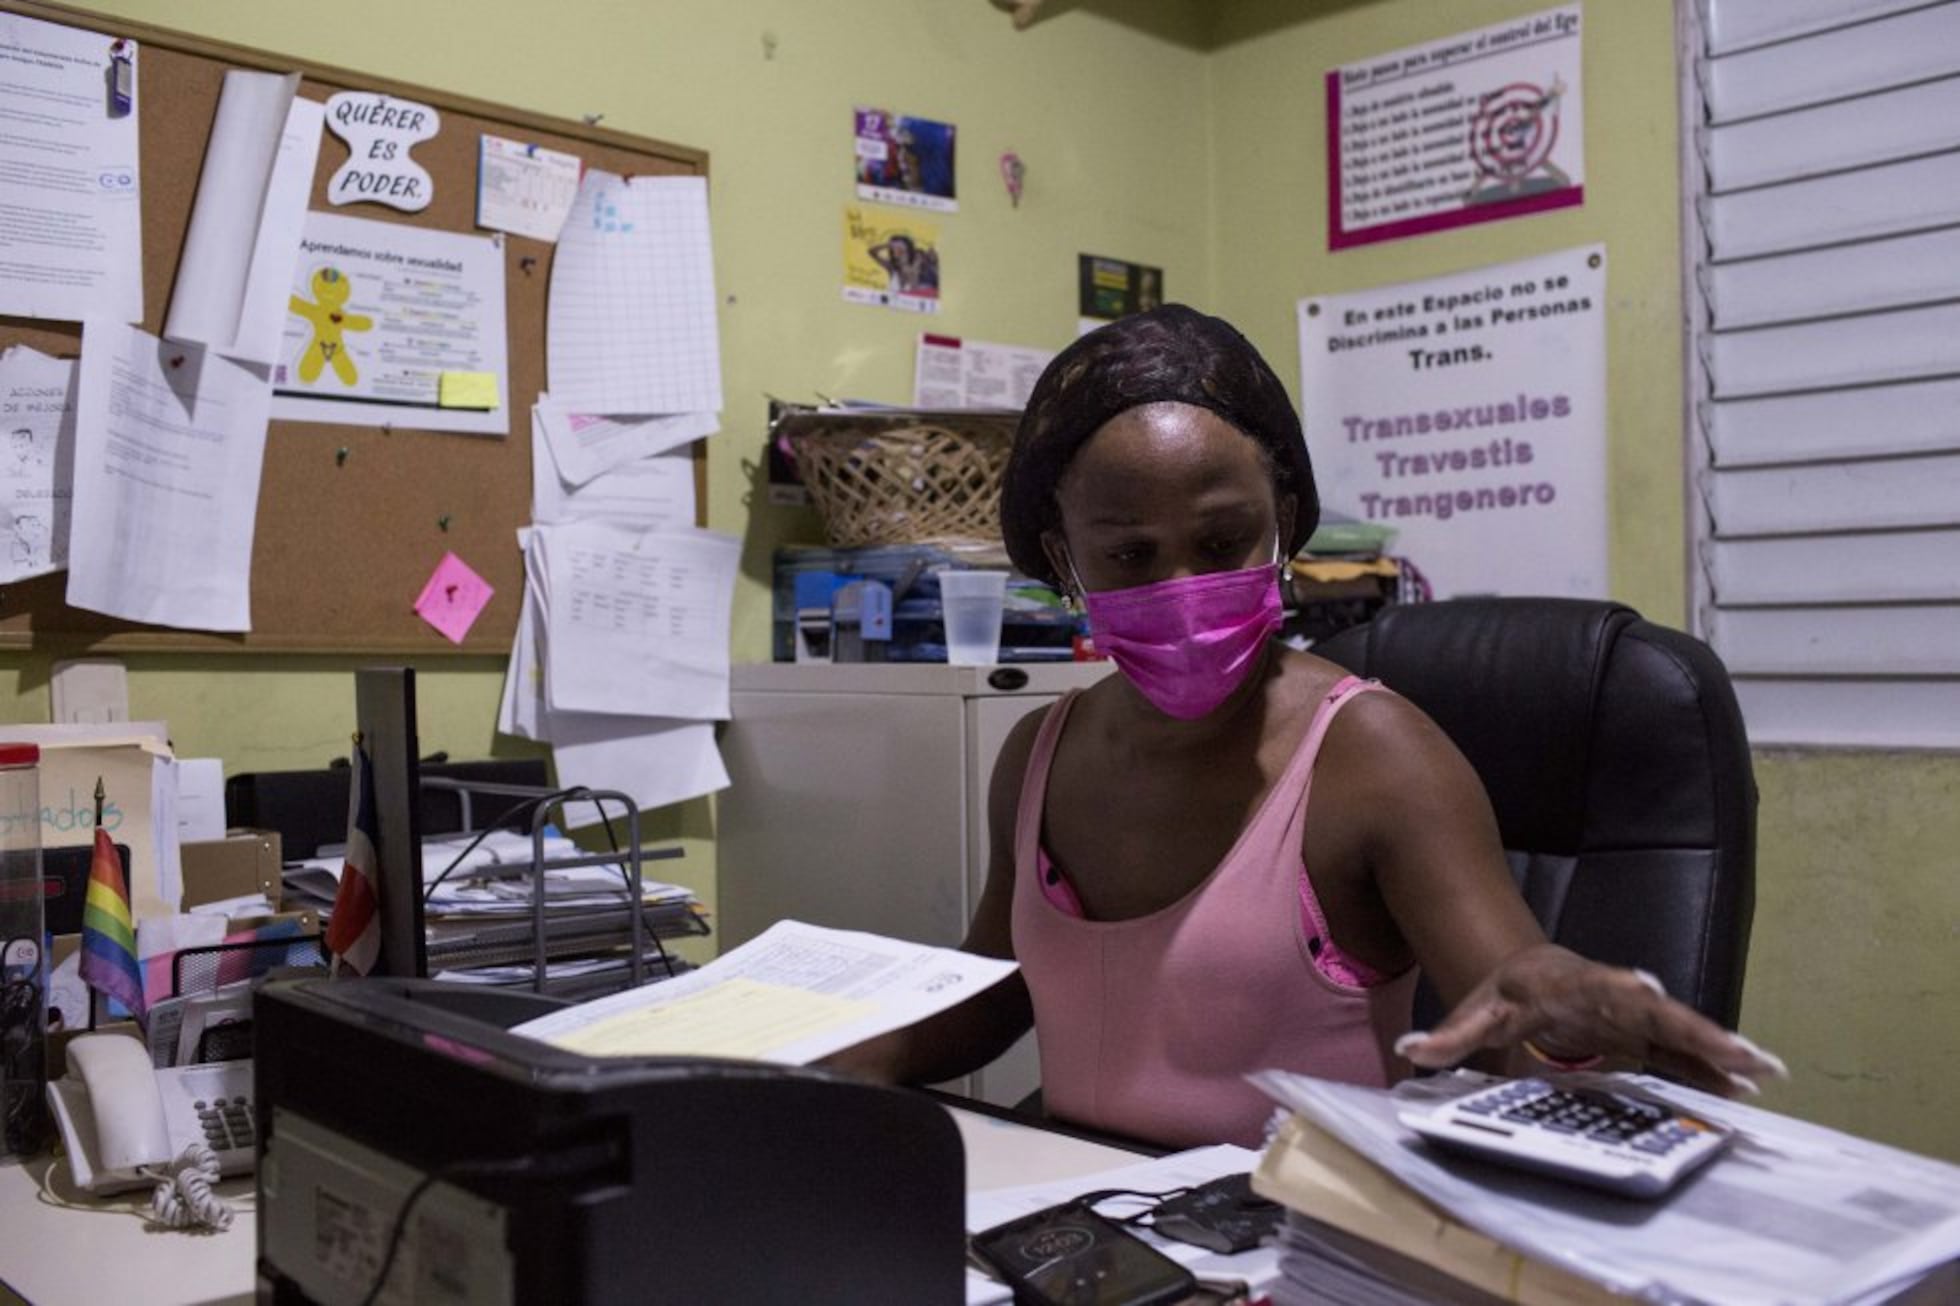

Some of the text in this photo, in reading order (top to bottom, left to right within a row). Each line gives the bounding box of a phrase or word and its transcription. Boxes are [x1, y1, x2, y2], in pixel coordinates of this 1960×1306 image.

[368, 139, 399, 160] ES
[339, 170, 423, 200] PODER.
[300, 239, 463, 273] Aprendamos sobre sexualidad
[1344, 275, 1569, 327] En este Espacio no se
[1328, 297, 1592, 353] Discrimina a las Personas
[1409, 344, 1493, 371] Trans.
[1342, 394, 1572, 443] Transexuales
[1376, 438, 1534, 479] Travestis
[1360, 481, 1556, 520] Trangenero
